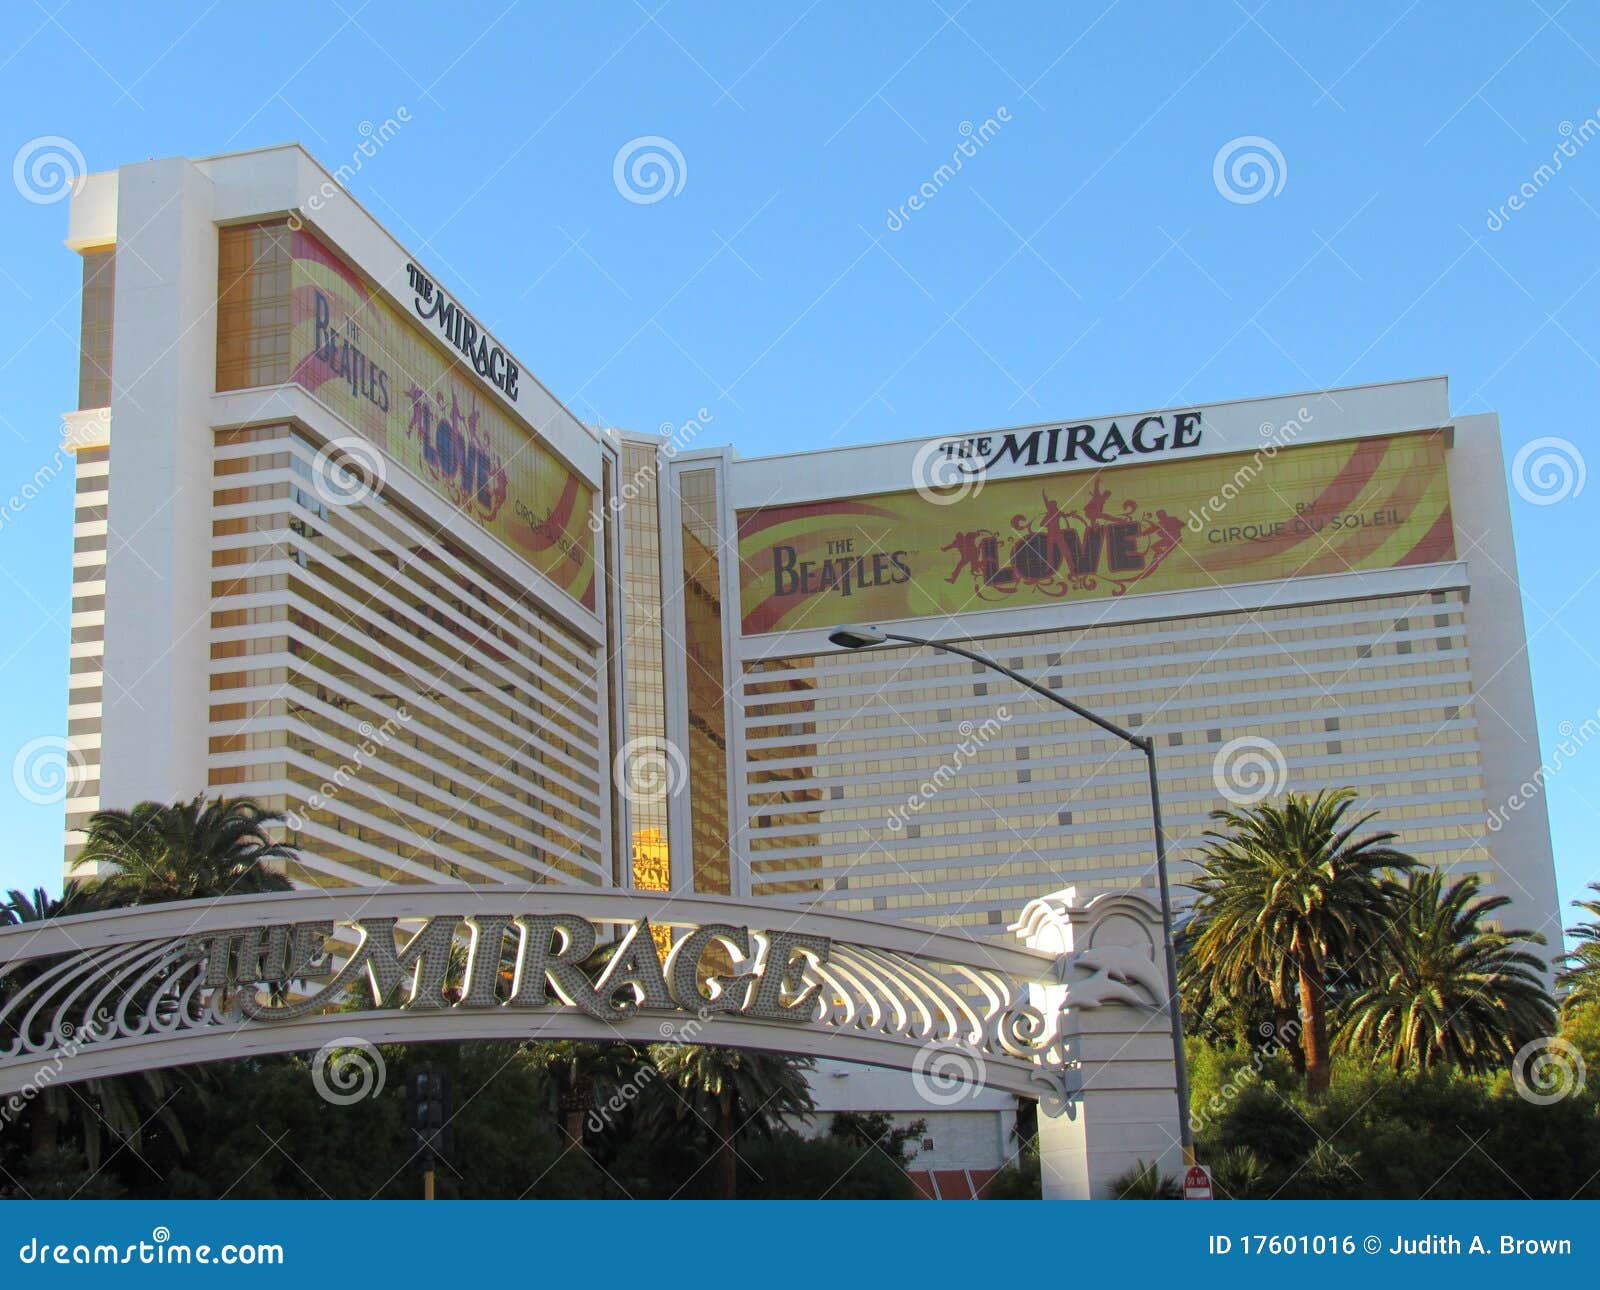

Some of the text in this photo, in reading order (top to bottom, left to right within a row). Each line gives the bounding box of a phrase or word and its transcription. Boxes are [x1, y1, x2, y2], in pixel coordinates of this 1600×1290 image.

[315, 288, 389, 413] BEATLES
[407, 263, 519, 402] THE MIRAGE
[939, 412, 1202, 475] THE MIRAGE
[826, 538, 854, 555] THE
[979, 521, 1147, 586] LOVE
[1208, 522, 1286, 544] CIRQUE
[1331, 509, 1405, 530] SOLEIL
[772, 545, 912, 597] BEATLES
[187, 914, 832, 1023] THE MIRAGE
